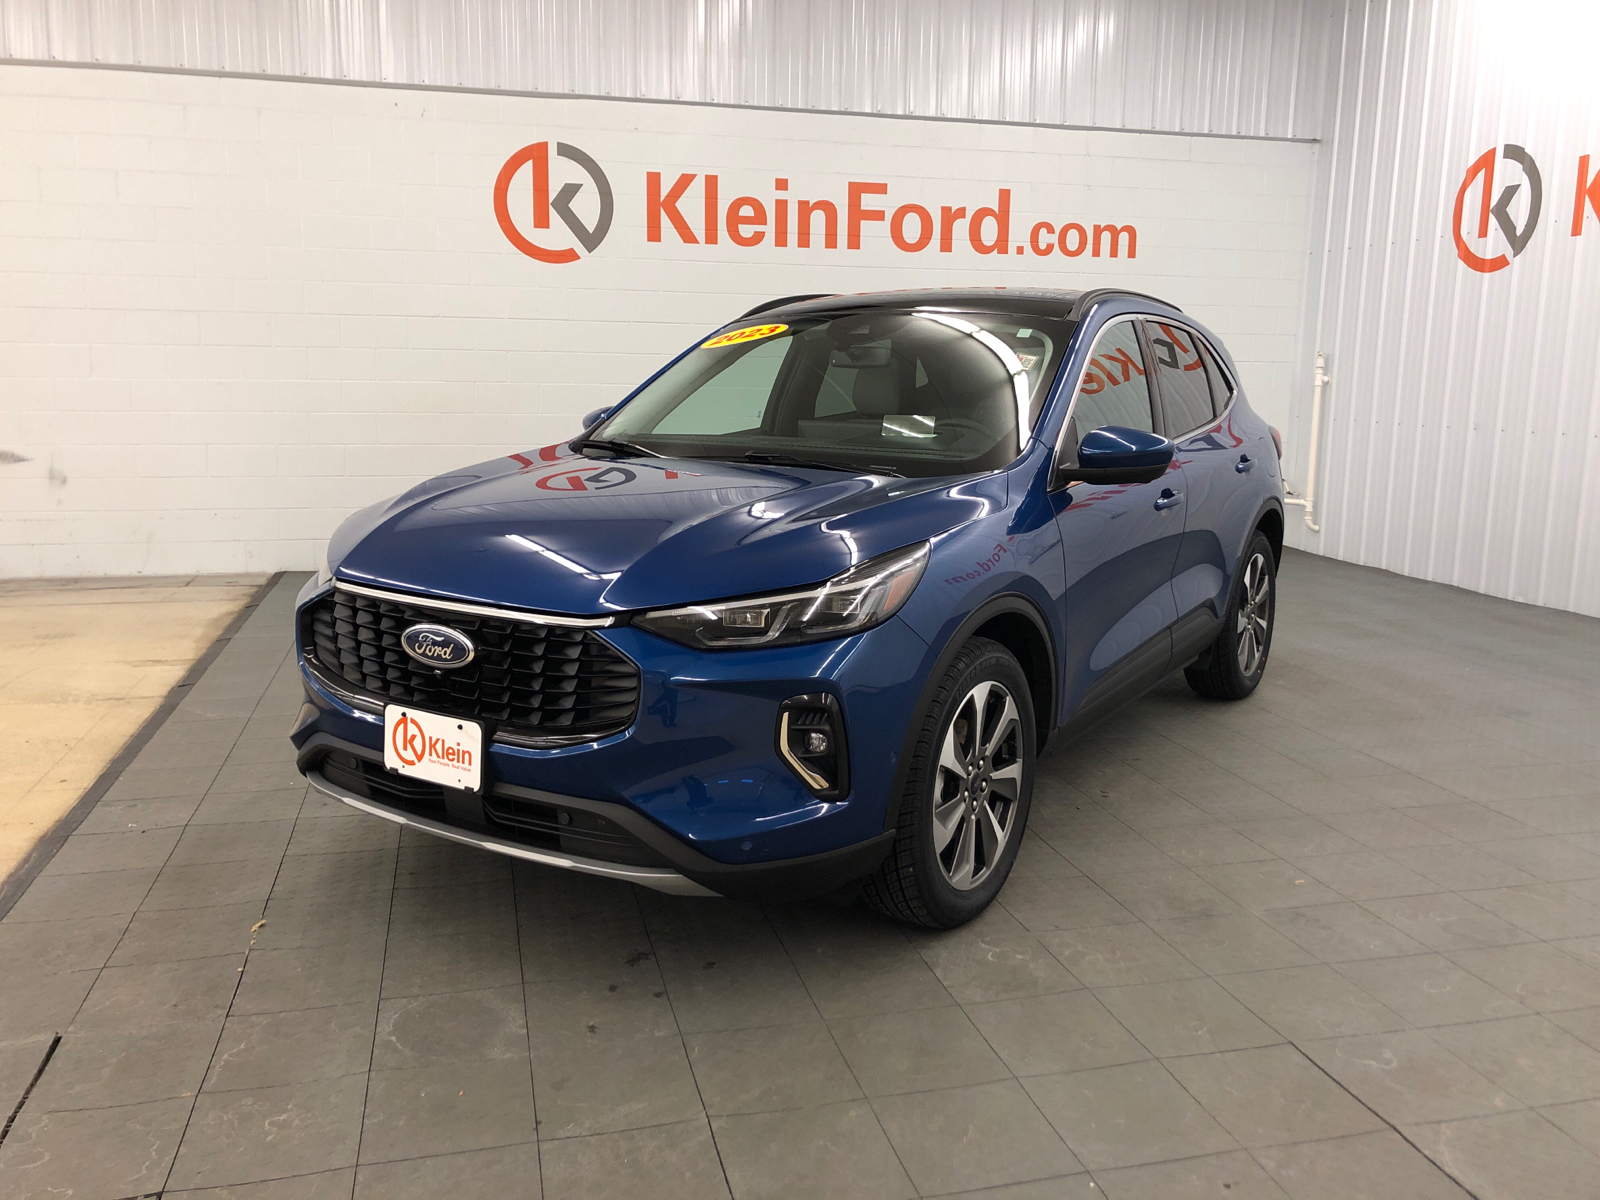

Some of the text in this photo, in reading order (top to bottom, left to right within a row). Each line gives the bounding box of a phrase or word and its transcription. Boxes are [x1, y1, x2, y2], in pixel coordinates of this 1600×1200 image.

[646, 171, 1138, 259] KleinFord.com
[707, 326, 781, 346] 2023
[415, 632, 454, 660] Ford
[428, 736, 472, 766] Klein
